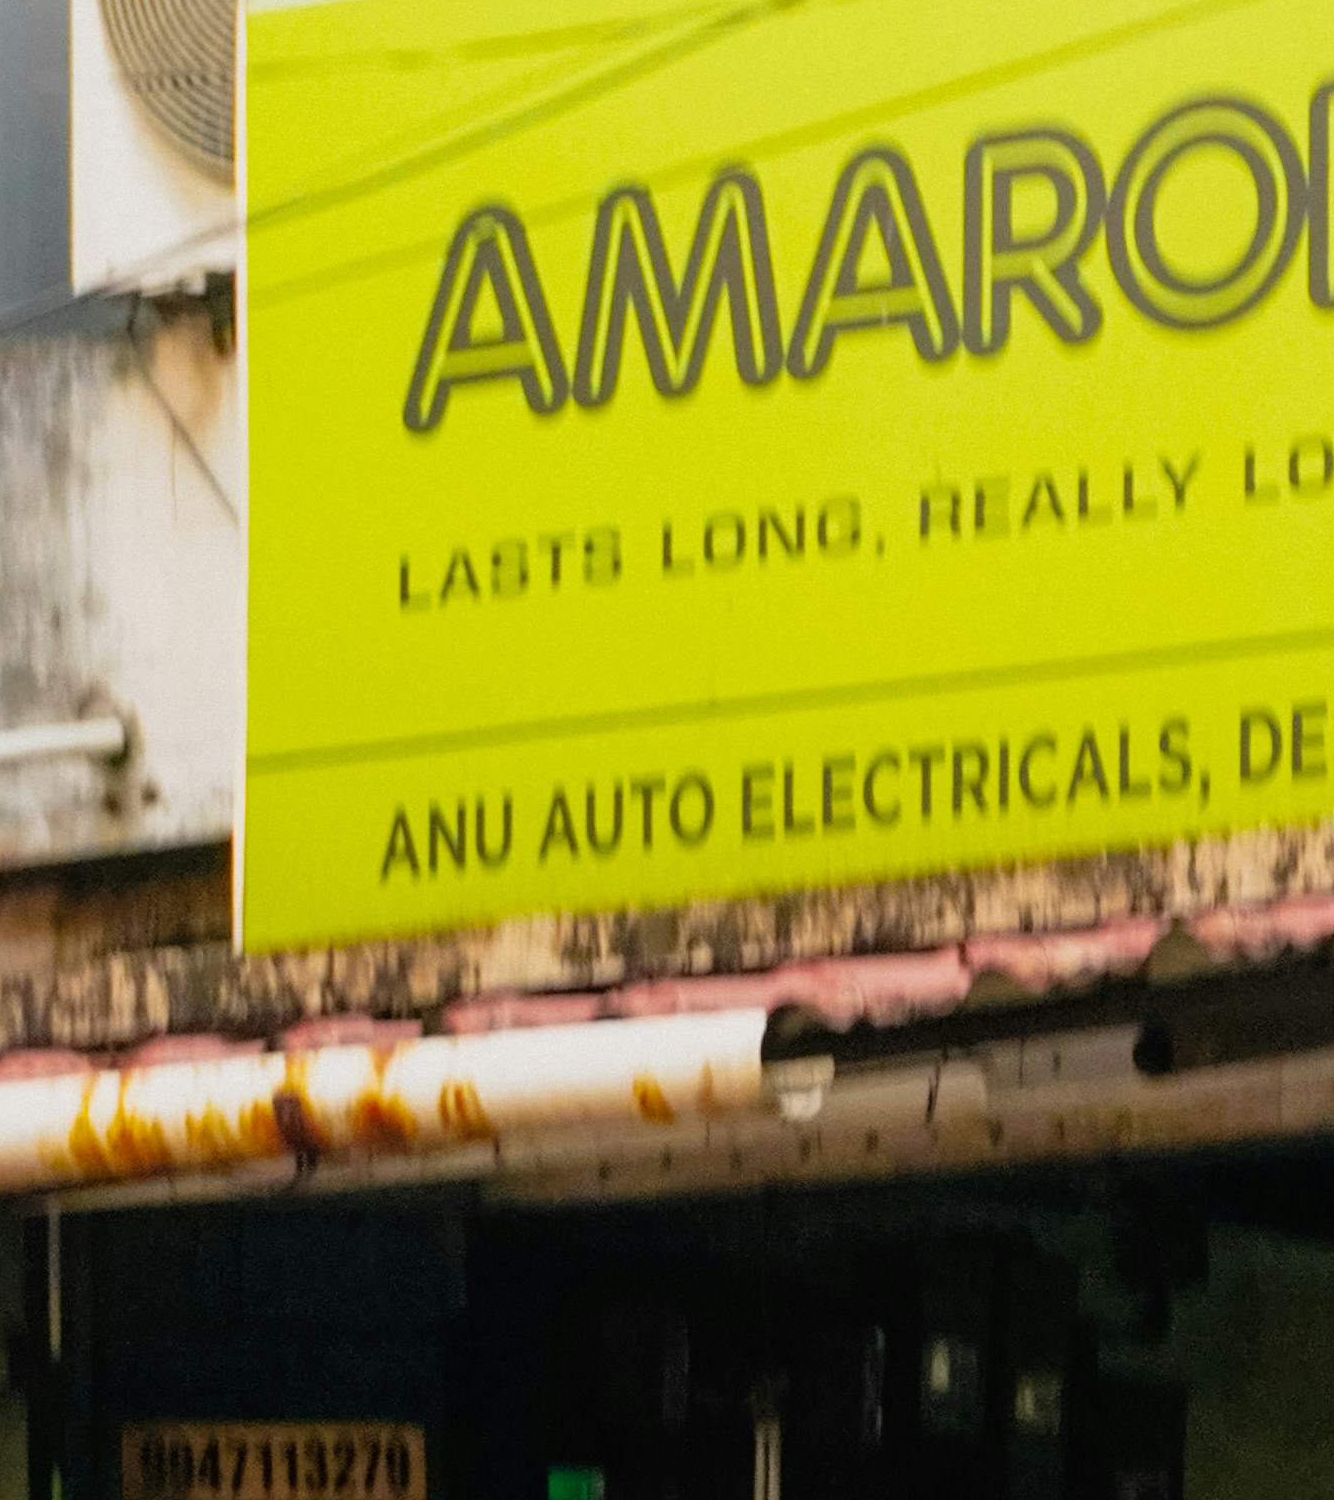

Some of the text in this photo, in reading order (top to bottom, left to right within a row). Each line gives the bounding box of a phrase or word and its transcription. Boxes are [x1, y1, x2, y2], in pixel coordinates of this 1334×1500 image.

[398, 526, 623, 612] LASTS
[918, 452, 1203, 543] REALLY
[379, 796, 515, 884] ANU
[537, 773, 715, 863] AUTO
[740, 718, 1211, 841] ELECTRICALS,
